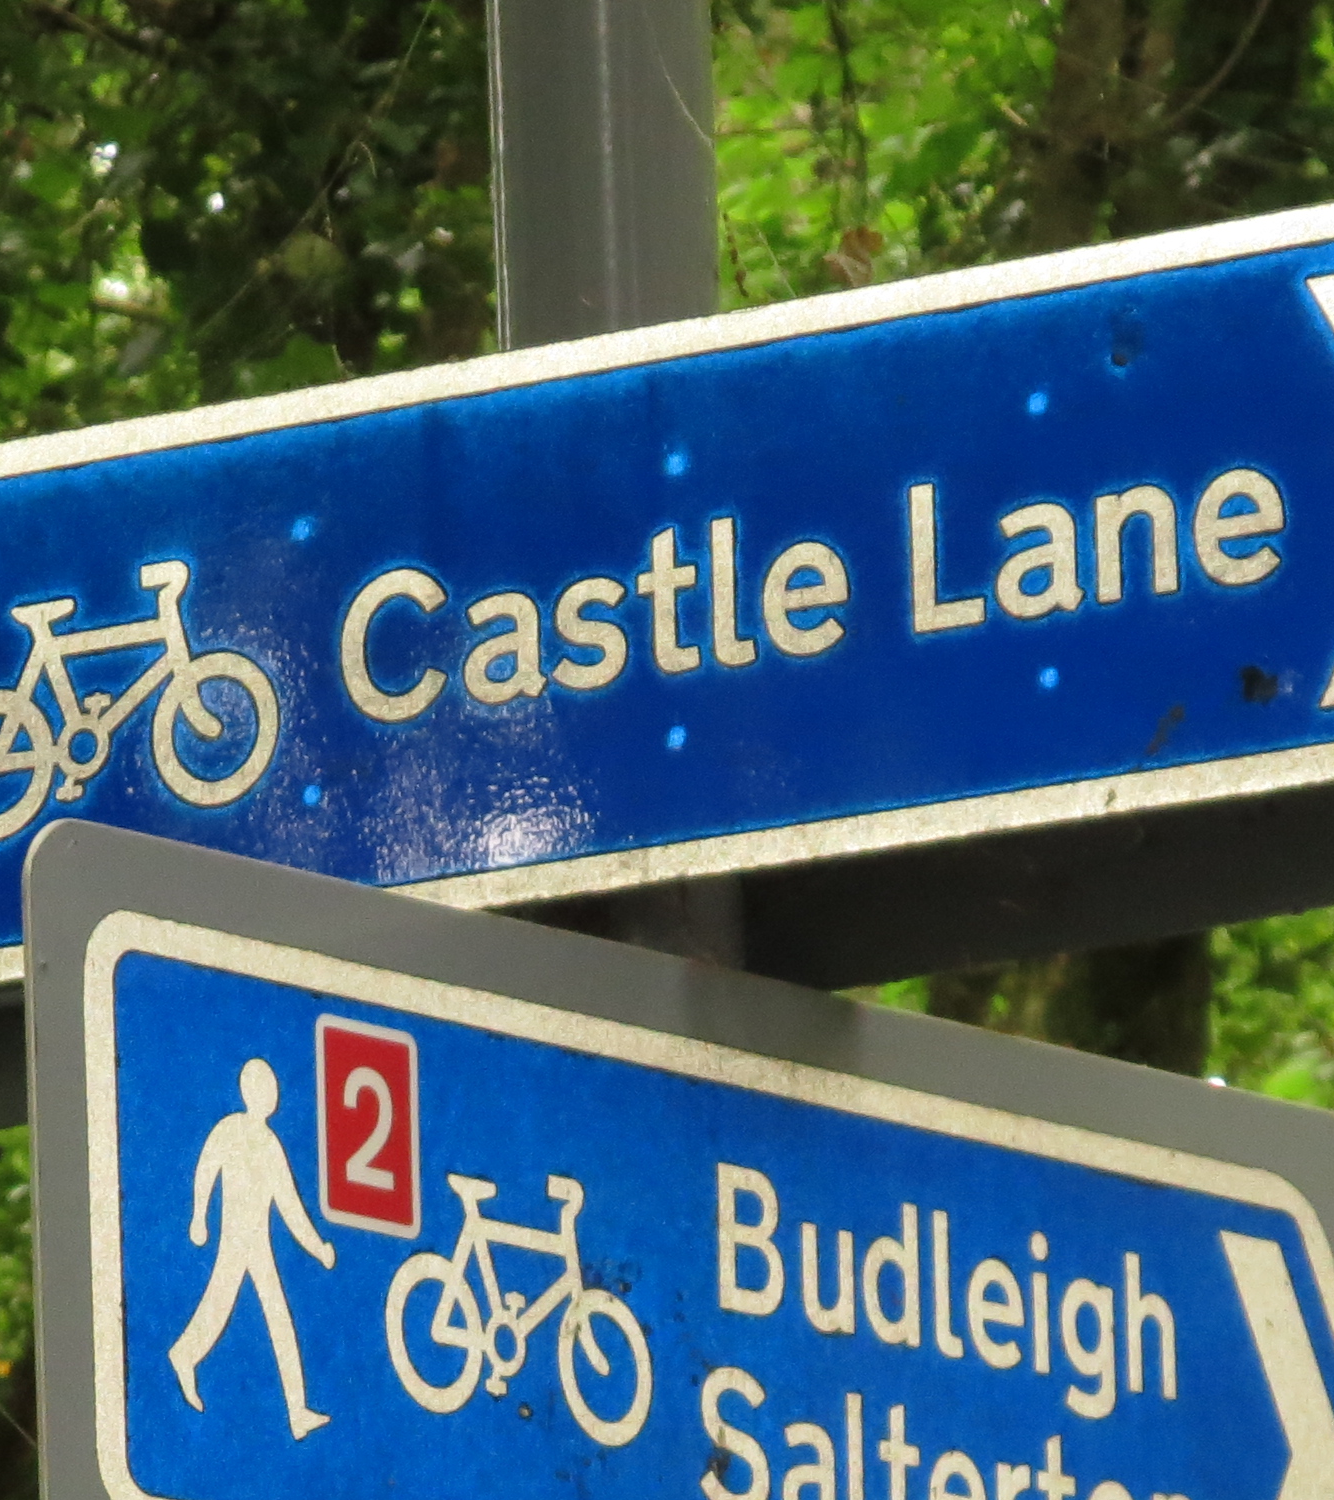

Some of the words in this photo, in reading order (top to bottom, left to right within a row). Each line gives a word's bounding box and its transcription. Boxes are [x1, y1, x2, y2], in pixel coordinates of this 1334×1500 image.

[340, 516, 849, 722] Castle
[909, 468, 1285, 634] Lane
[342, 1065, 396, 1191] 2
[716, 1160, 1178, 1420] Budleigh
